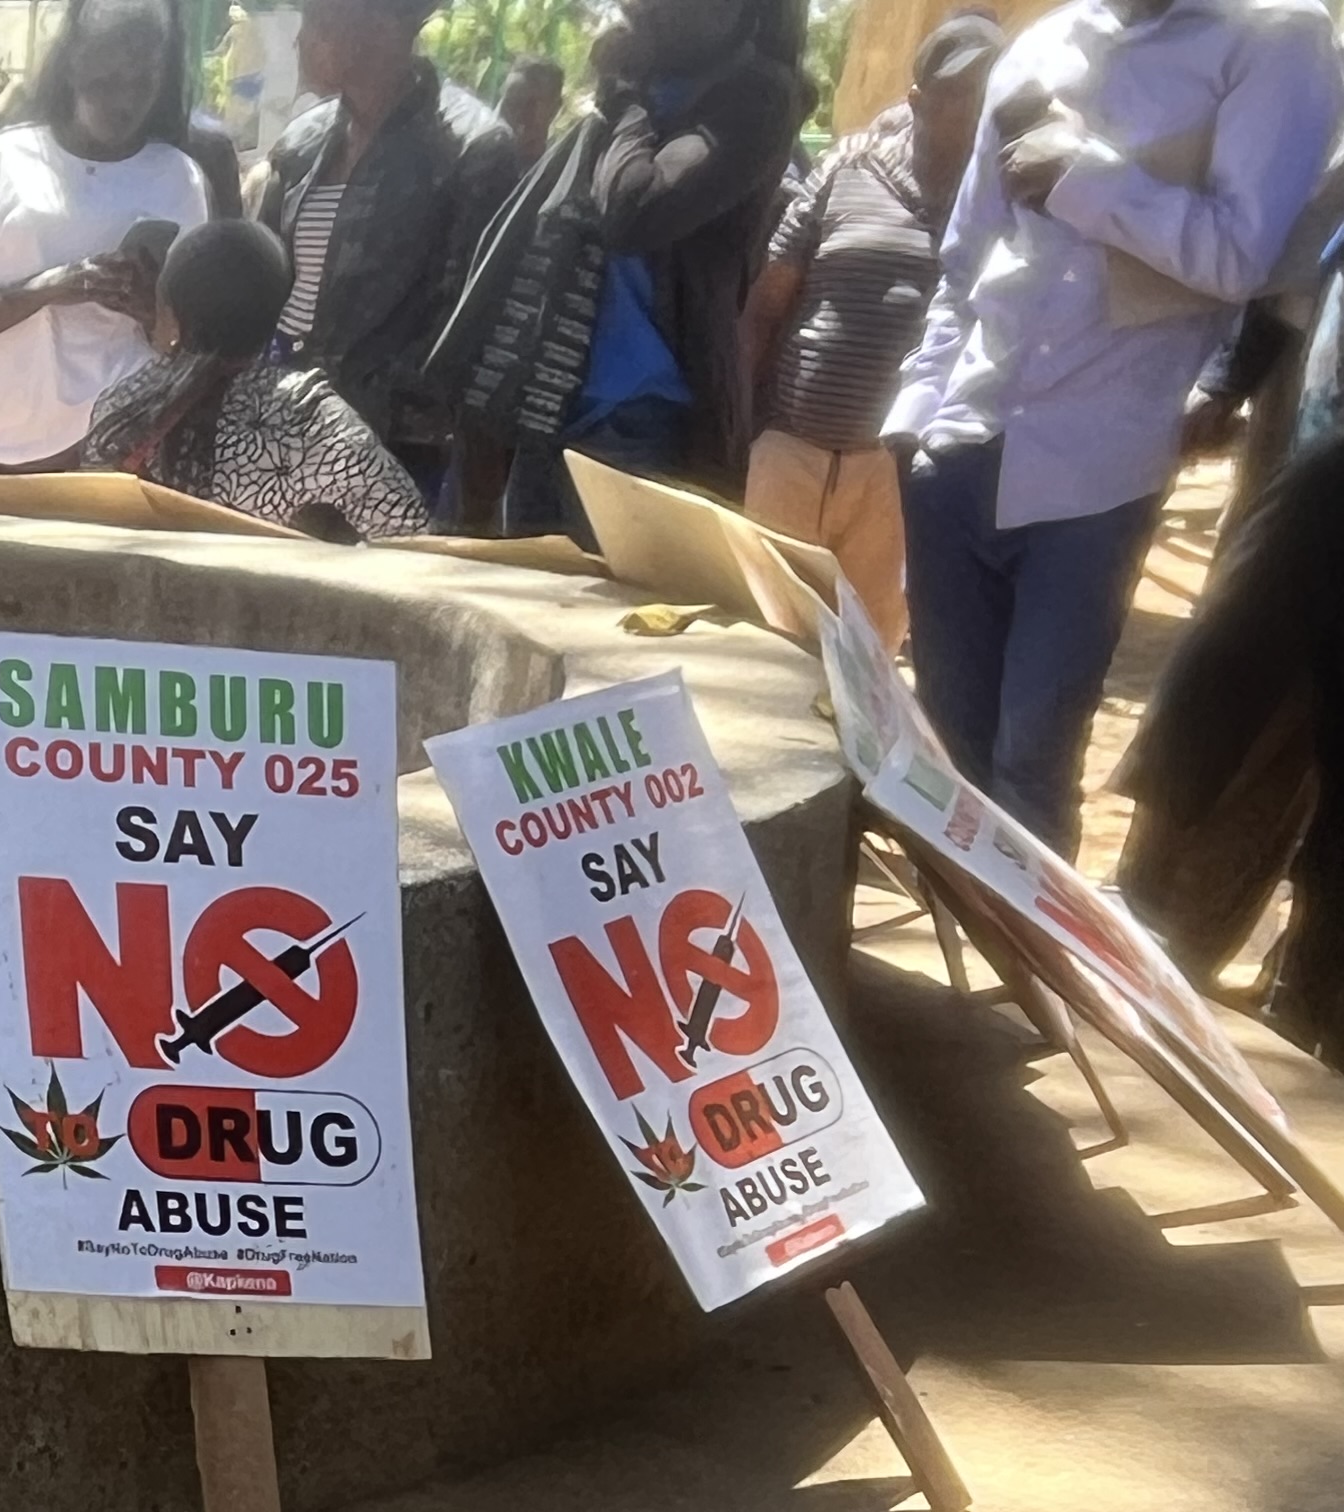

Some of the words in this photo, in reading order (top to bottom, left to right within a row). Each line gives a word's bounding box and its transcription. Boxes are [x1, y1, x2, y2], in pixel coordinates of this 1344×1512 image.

[4, 736, 245, 790] COUNTY
[265, 755, 360, 798] 025
[496, 708, 652, 804] KWALE
[115, 806, 259, 868] SAY
[495, 787, 635, 857] COUNTY
[646, 763, 705, 809] 002
[581, 831, 667, 903] SAY
[17, 876, 359, 1078] NO
[548, 889, 779, 1101] NO
[29, 1110, 100, 1159] TO
[156, 1103, 359, 1168] DRUG
[703, 1064, 832, 1153] DRUG
[118, 1188, 307, 1239] ABUSE
[720, 1147, 831, 1227] ABUSE
